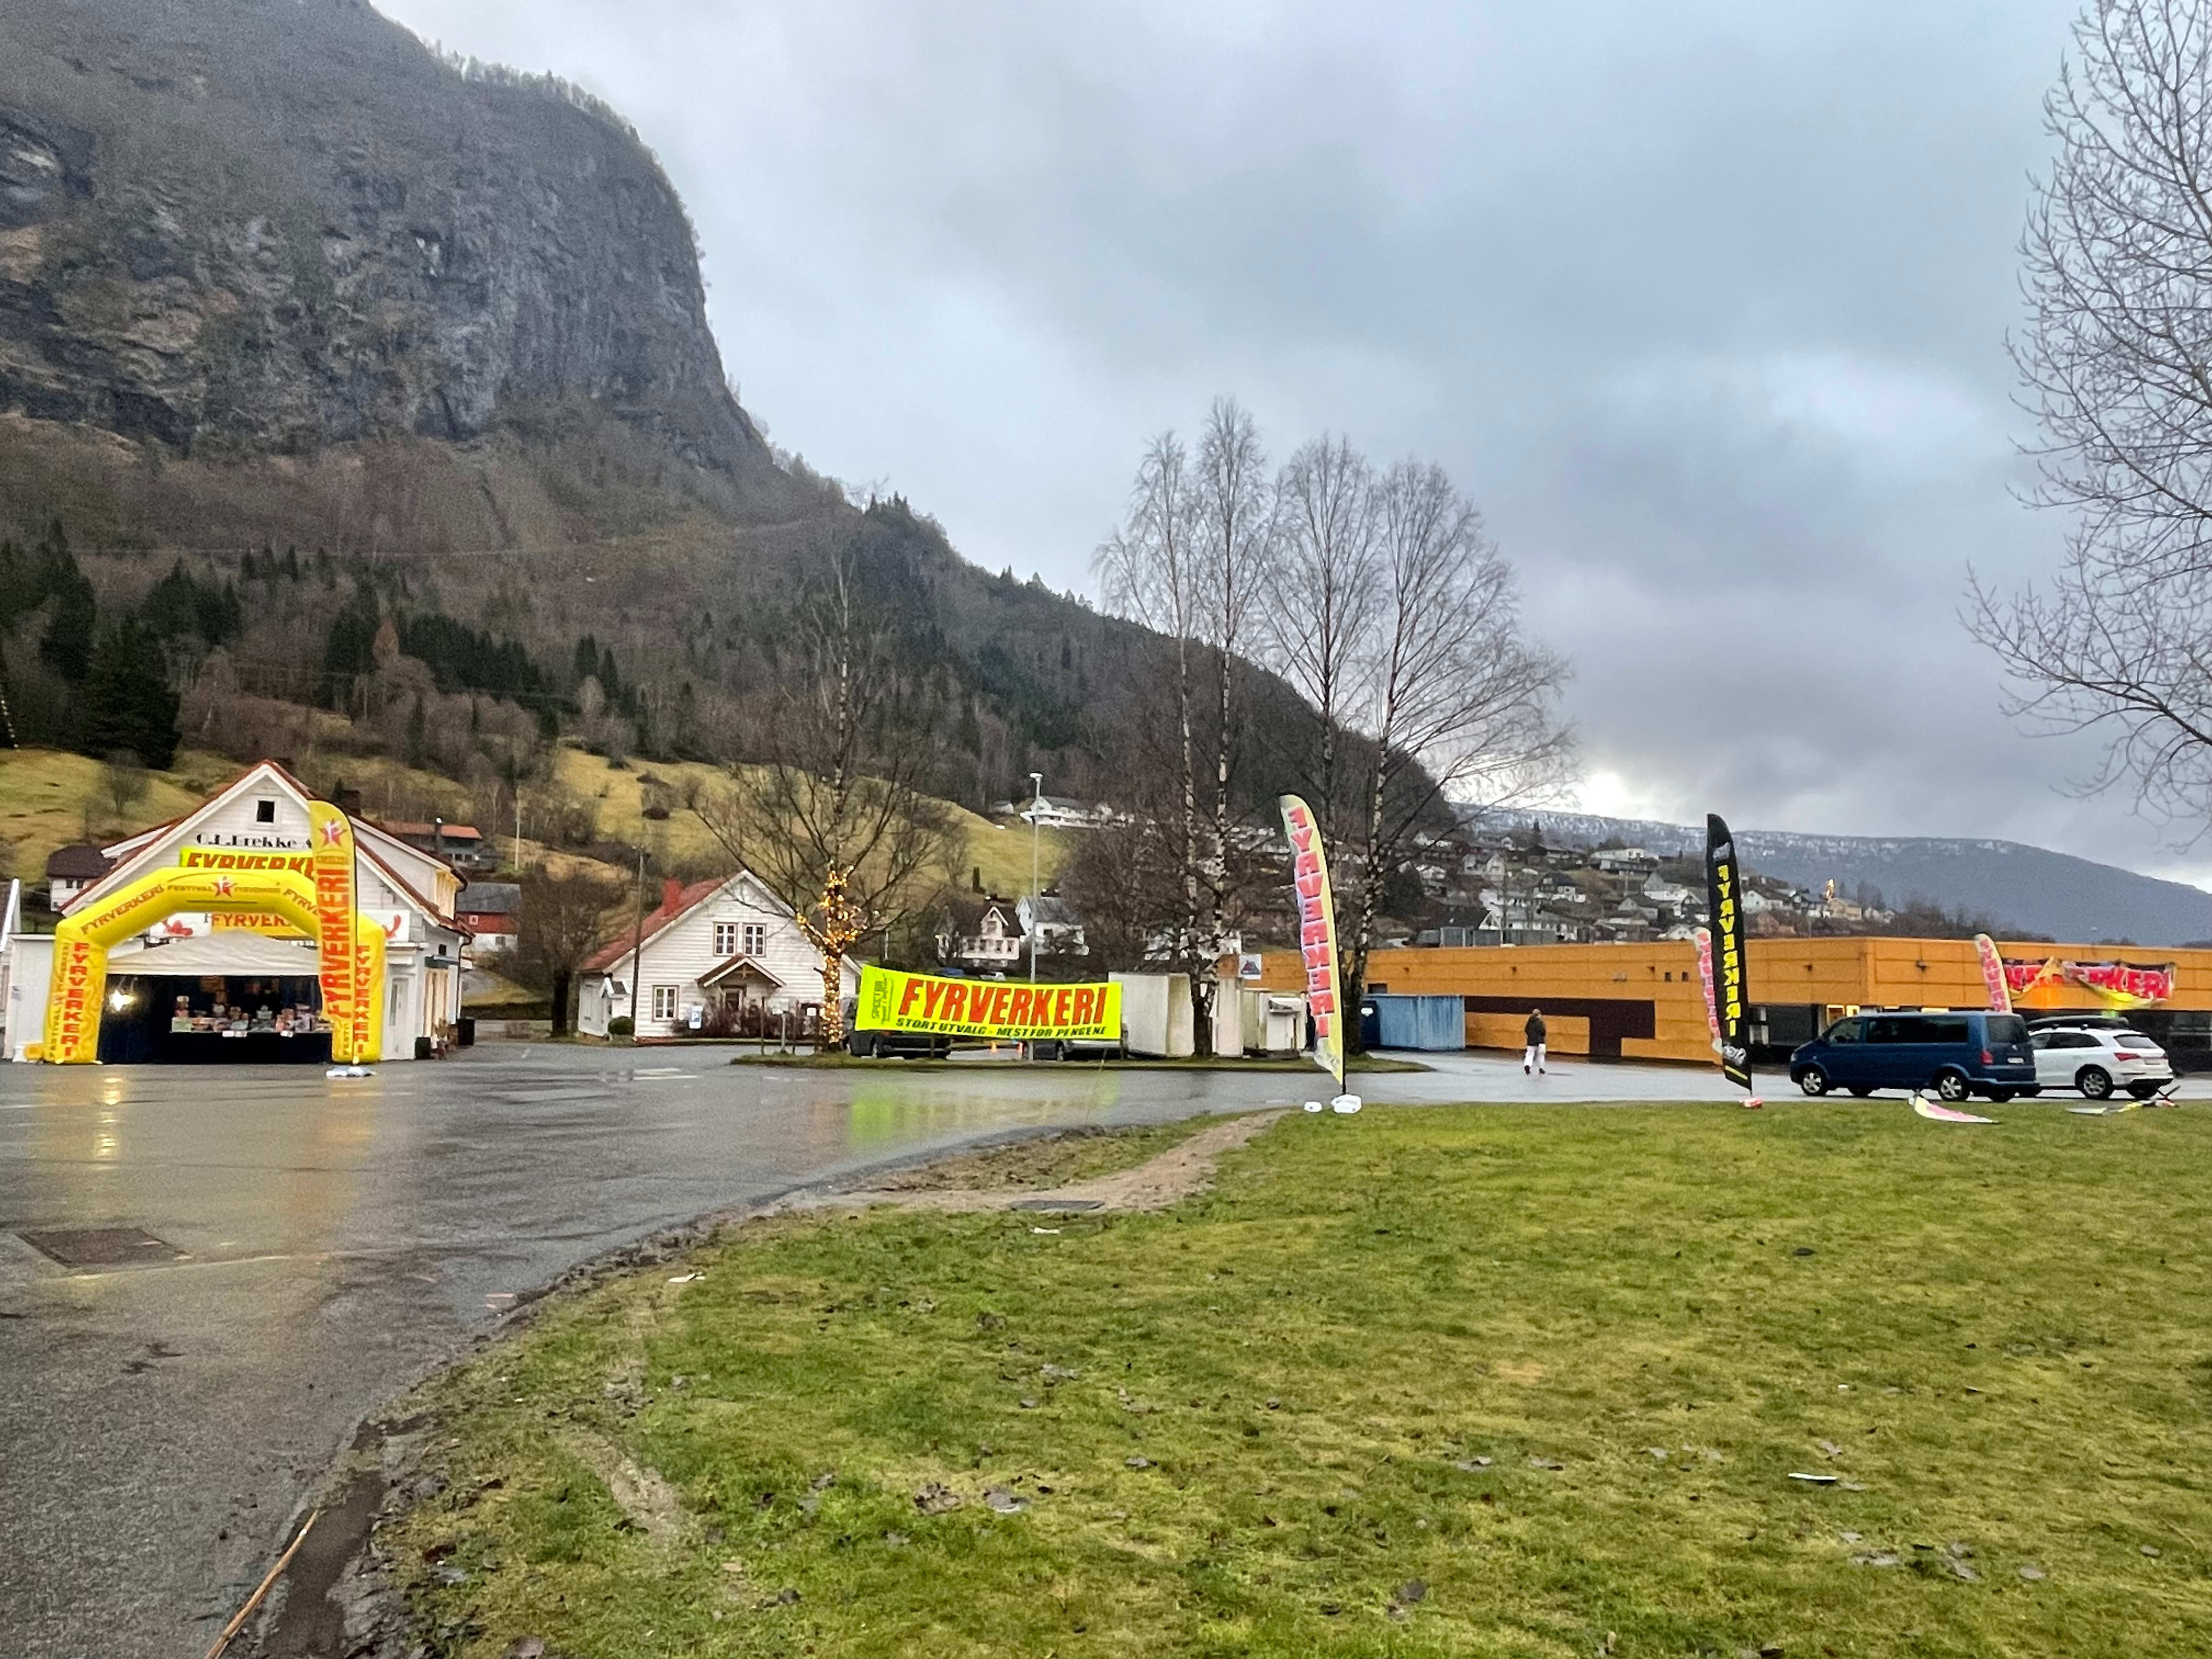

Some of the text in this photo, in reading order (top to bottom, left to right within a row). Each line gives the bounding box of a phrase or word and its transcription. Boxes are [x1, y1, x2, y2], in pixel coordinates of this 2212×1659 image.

[81, 883, 163, 935] FYRVERKERI
[317, 869, 351, 1018] FYRVERKERI
[60, 943, 90, 1057] FYRVERKERI
[899, 978, 1108, 1026] FYRVERKERI
[896, 1017, 938, 1031] STORT
[938, 1023, 988, 1035] UTVALG
[1030, 1028, 1053, 1037] FOR
